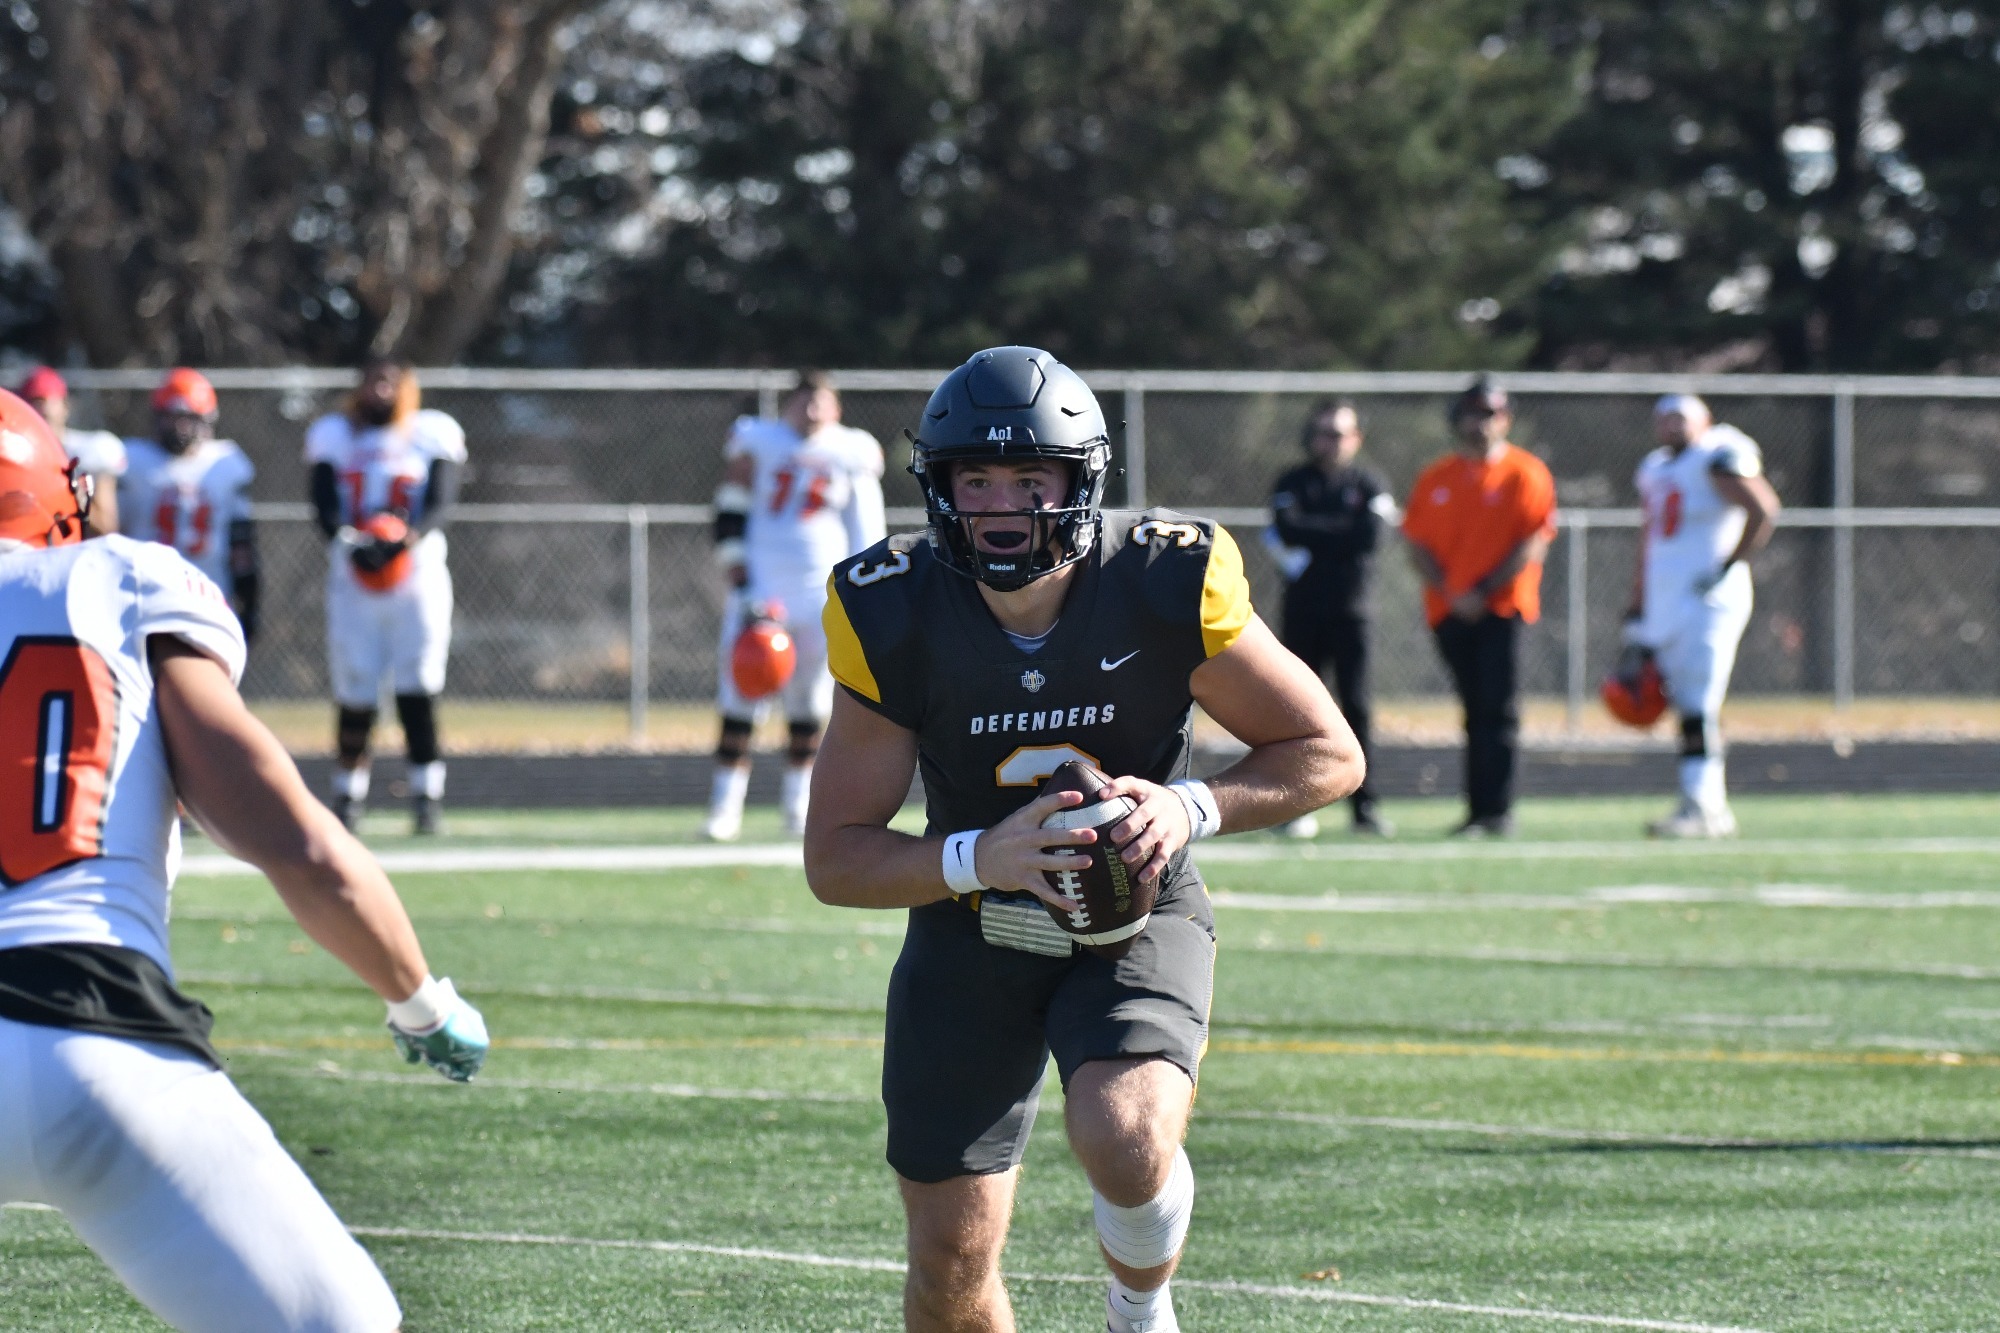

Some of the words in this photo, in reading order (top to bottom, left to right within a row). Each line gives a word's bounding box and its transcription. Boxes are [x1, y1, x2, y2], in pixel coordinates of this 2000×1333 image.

[1132, 519, 1200, 548] 3
[847, 549, 912, 587] 3
[989, 563, 1016, 571] Riddell
[970, 704, 1115, 735] DEFENDERS
[0, 635, 121, 886] 0
